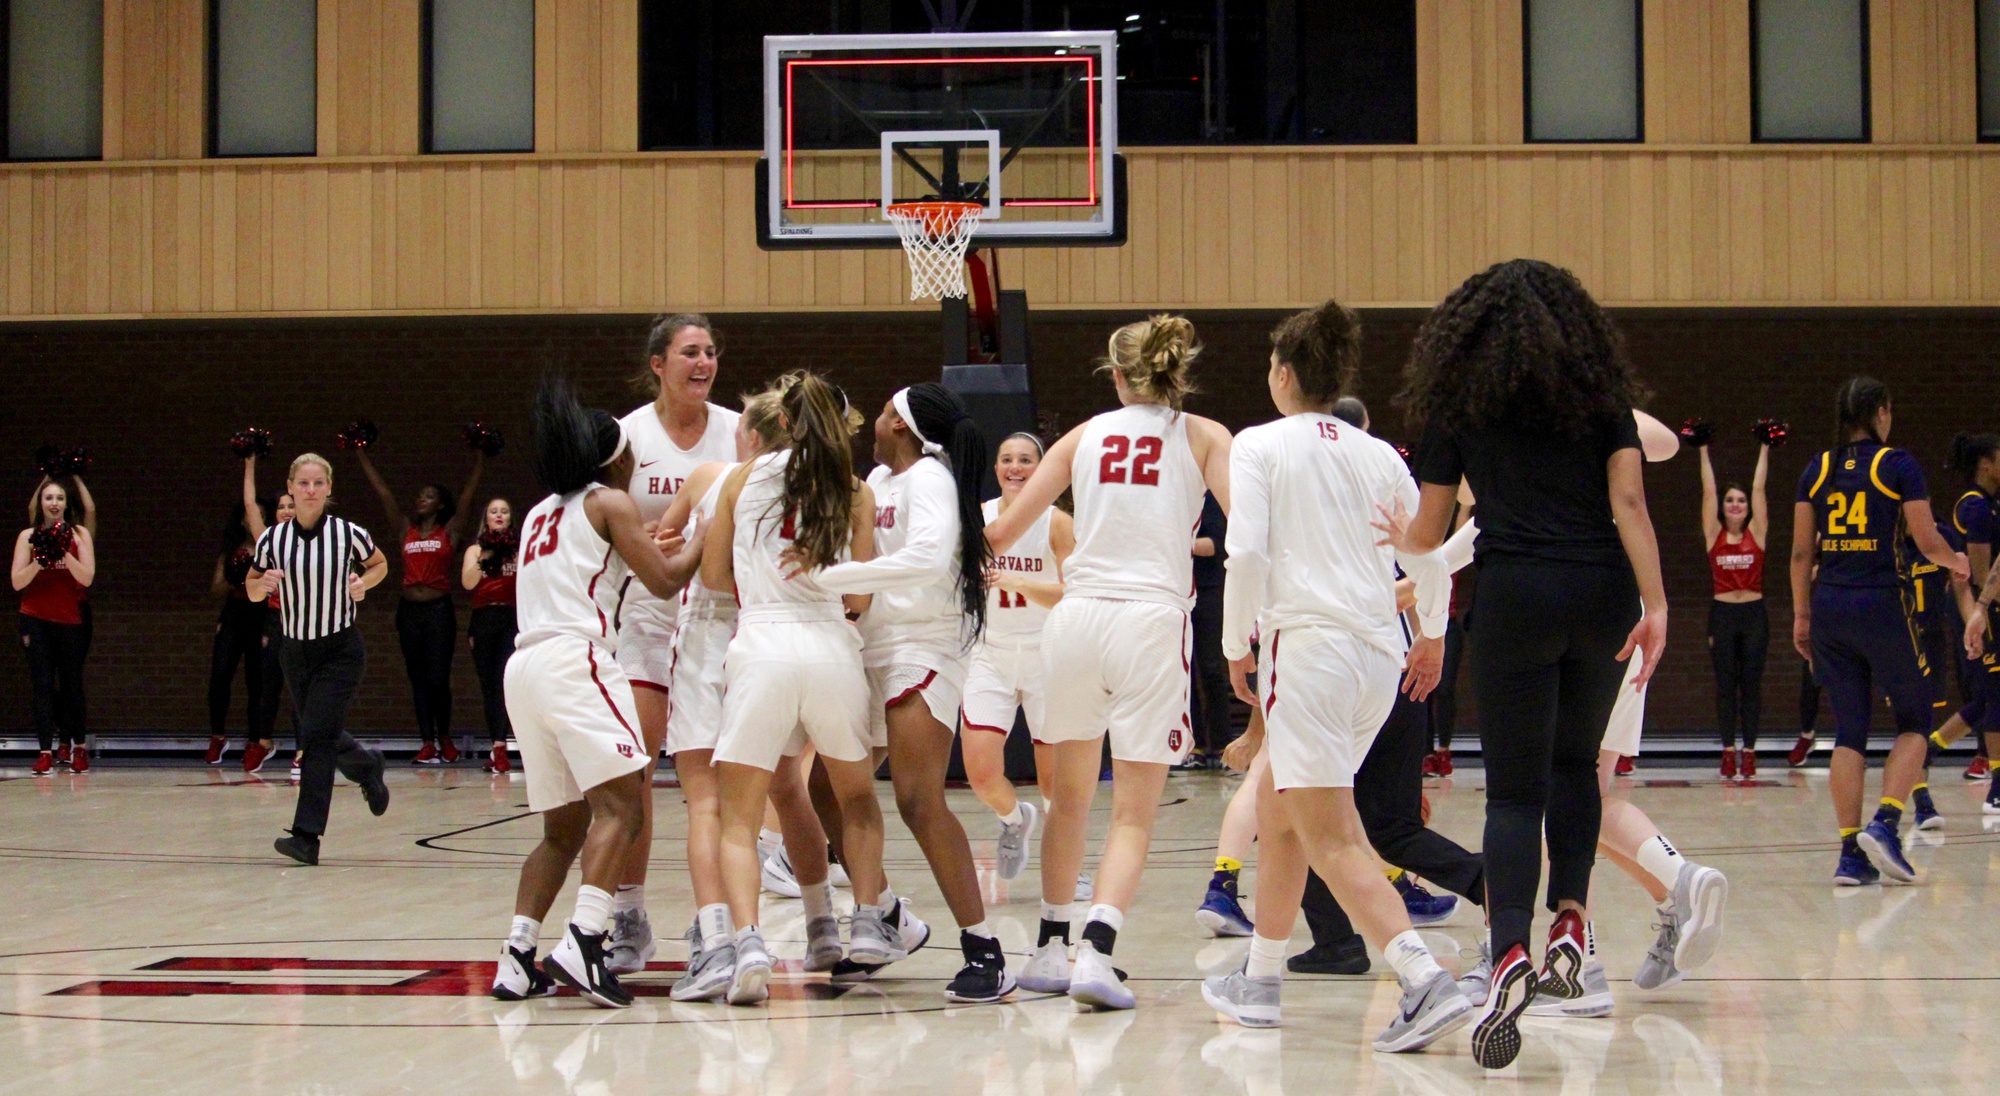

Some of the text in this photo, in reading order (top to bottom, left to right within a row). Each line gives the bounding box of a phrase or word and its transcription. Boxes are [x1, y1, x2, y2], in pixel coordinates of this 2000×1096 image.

[780, 227, 813, 235] SPALDING
[1316, 421, 1339, 441] 15
[1099, 434, 1163, 486] 22
[1827, 491, 1868, 534] 24
[523, 506, 565, 567] 23
[989, 555, 1043, 572] ARVARD
